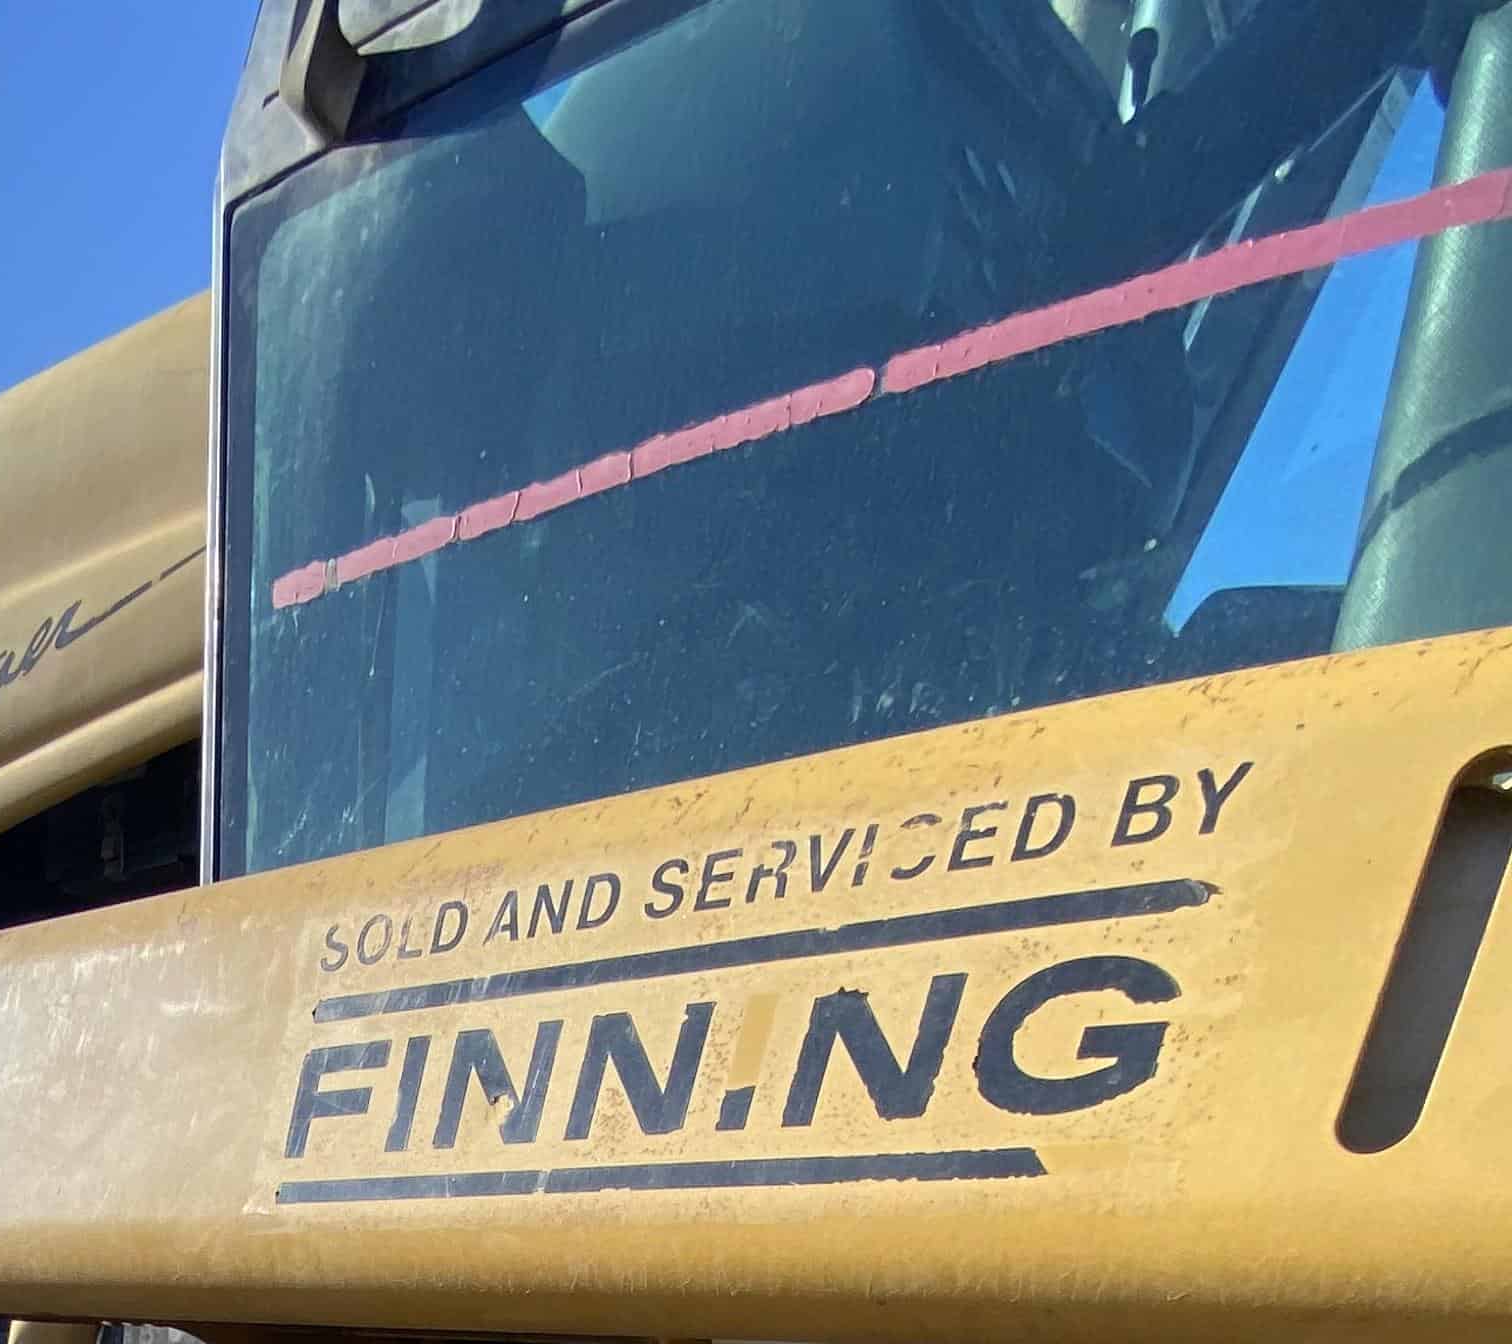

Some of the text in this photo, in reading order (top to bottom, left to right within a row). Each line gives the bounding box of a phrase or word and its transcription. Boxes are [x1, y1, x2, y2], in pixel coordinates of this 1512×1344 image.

[319, 761, 1254, 974] SOLD AND SERVICED BY
